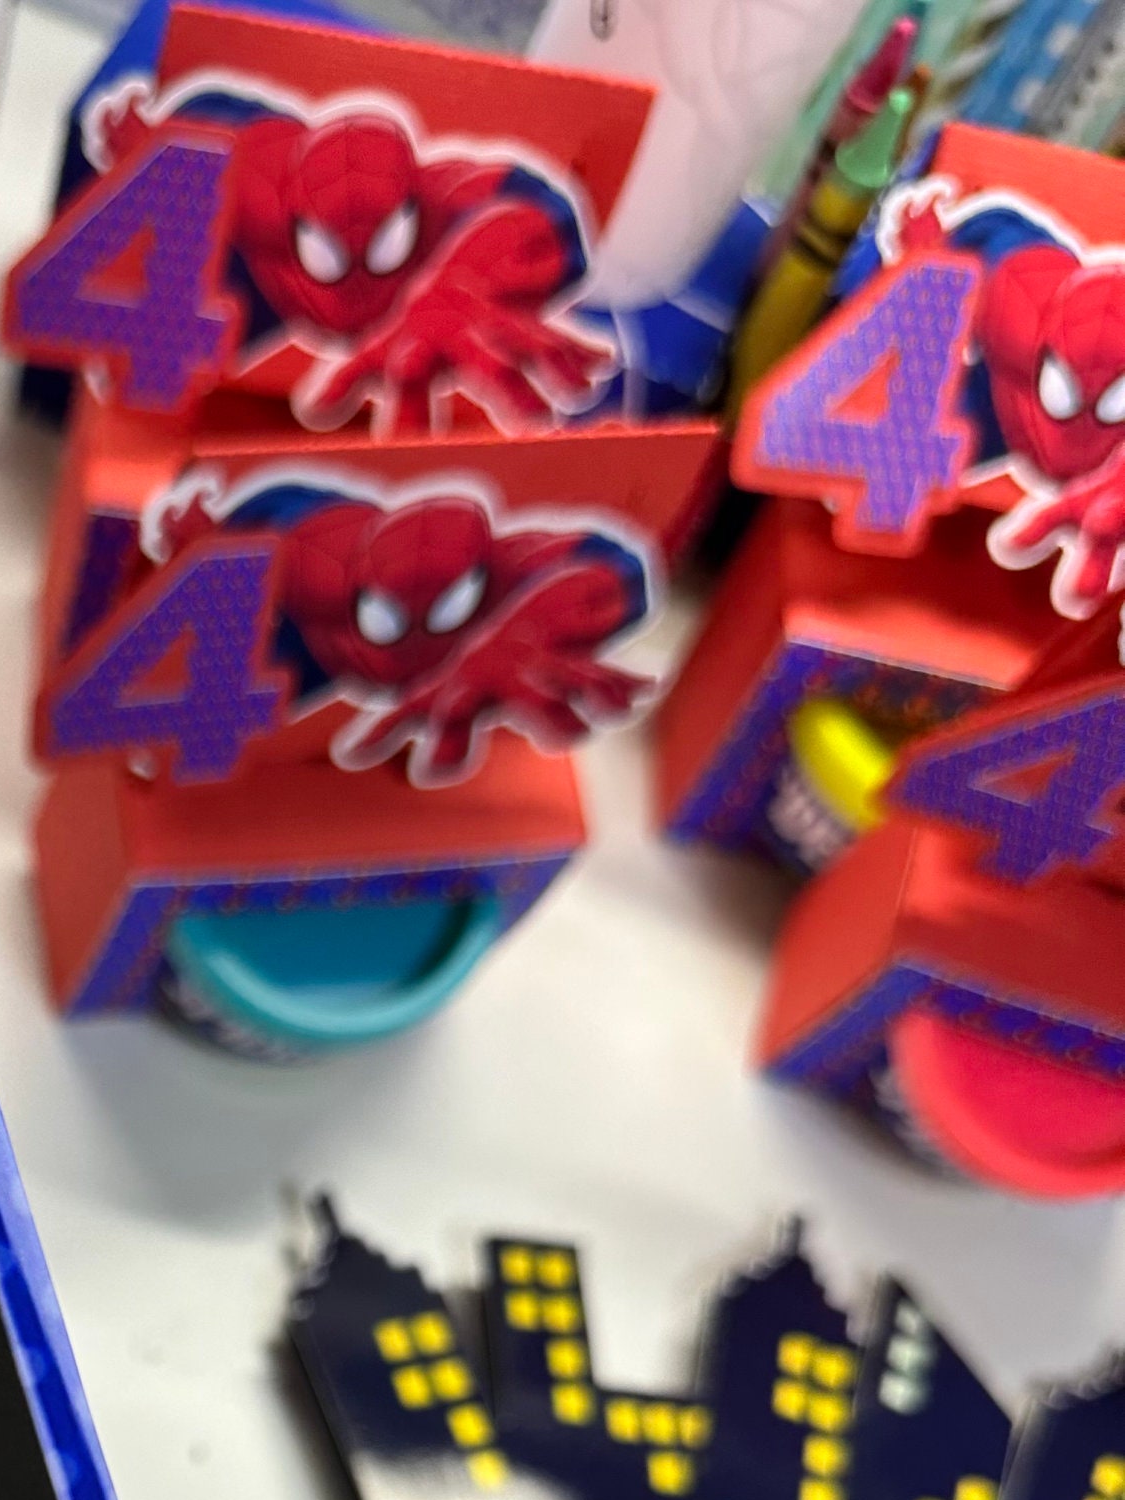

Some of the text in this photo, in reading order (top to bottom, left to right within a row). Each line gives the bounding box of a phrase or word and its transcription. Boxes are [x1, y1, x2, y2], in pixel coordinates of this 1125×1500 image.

[8, 136, 237, 416] 4
[743, 258, 973, 542] 4
[43, 542, 289, 786] 4
